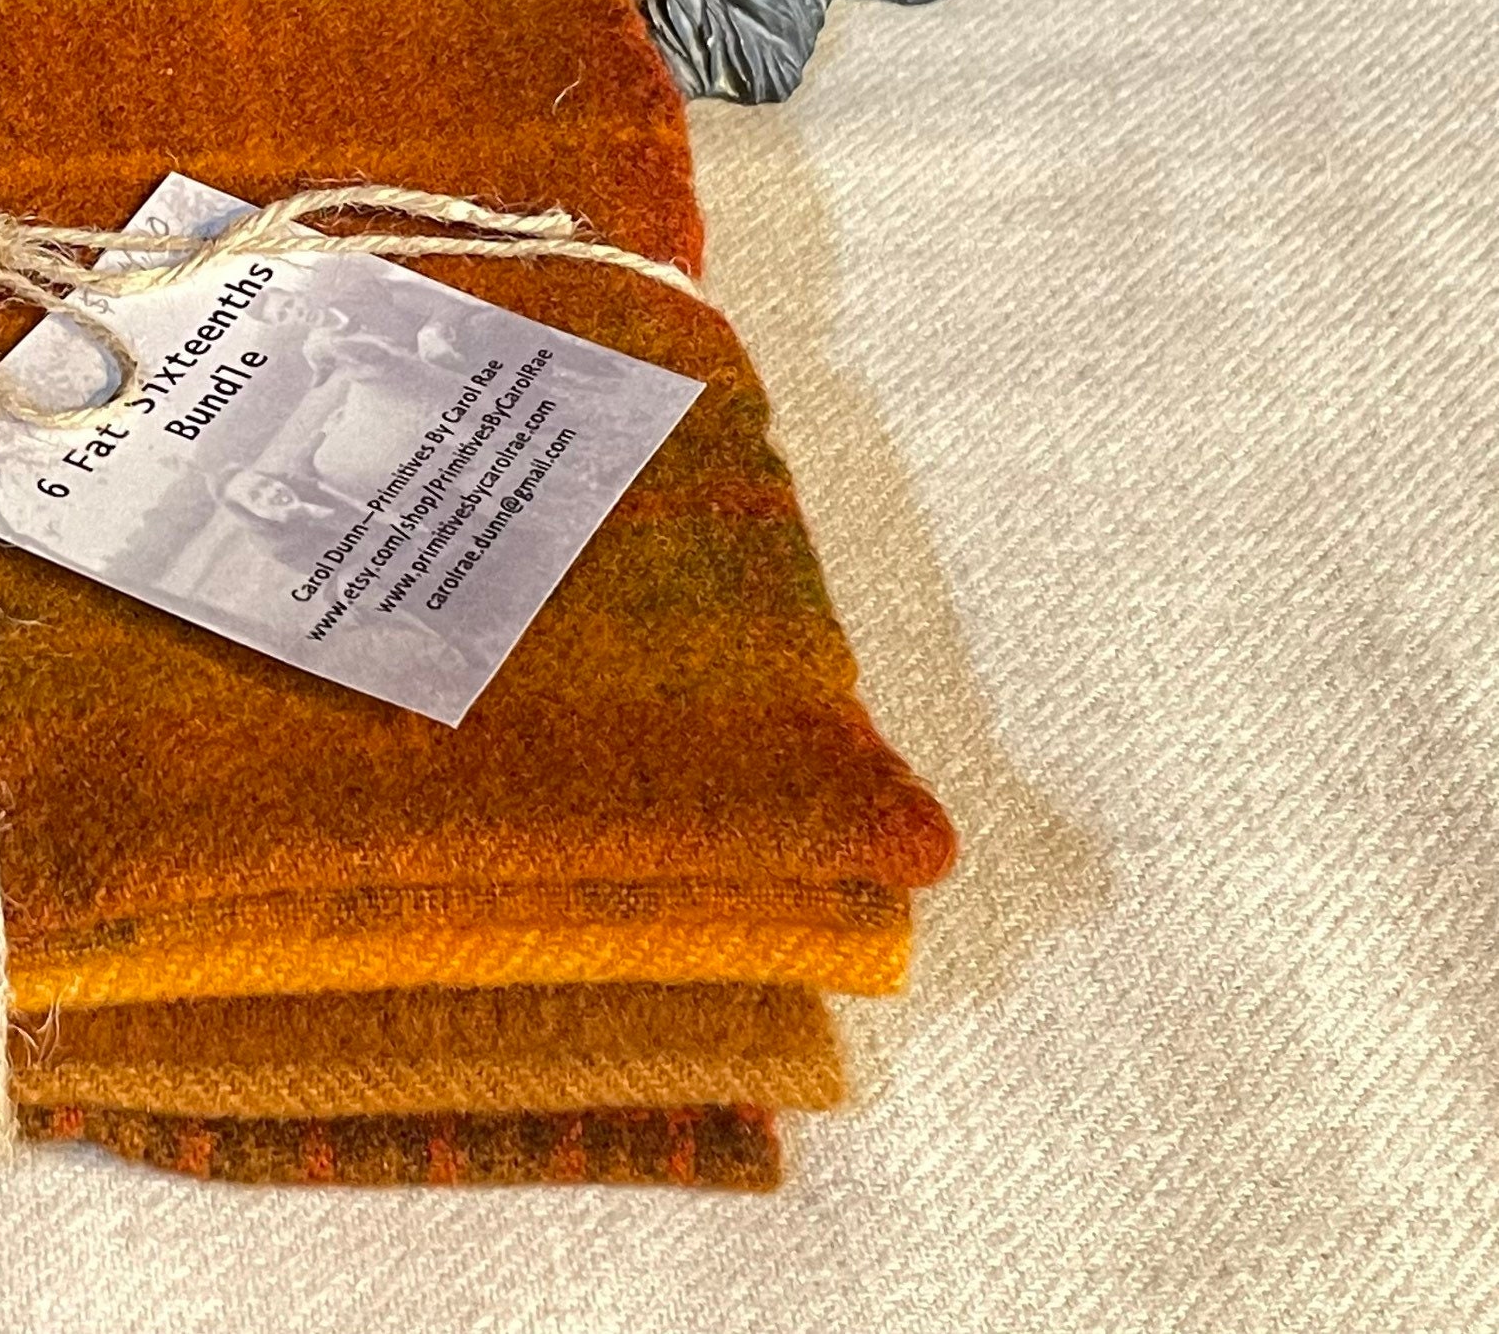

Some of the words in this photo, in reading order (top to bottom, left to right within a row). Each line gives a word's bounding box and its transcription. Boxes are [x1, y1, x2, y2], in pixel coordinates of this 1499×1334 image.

[37, 477, 70, 498] 6
[62, 423, 130, 472] Fat
[164, 350, 268, 441] Bundle
[291, 562, 329, 602] Carol
[425, 423, 455, 445] By
[441, 385, 482, 424] Carol
[471, 358, 504, 388] Rae
[306, 347, 554, 642] www.etsy.com/shop/PrimitivesByCarolRae
[375, 399, 556, 614] www.primitivesbycarolrae.com
[426, 428, 577, 611] carolrae.dunn@gmail.com
